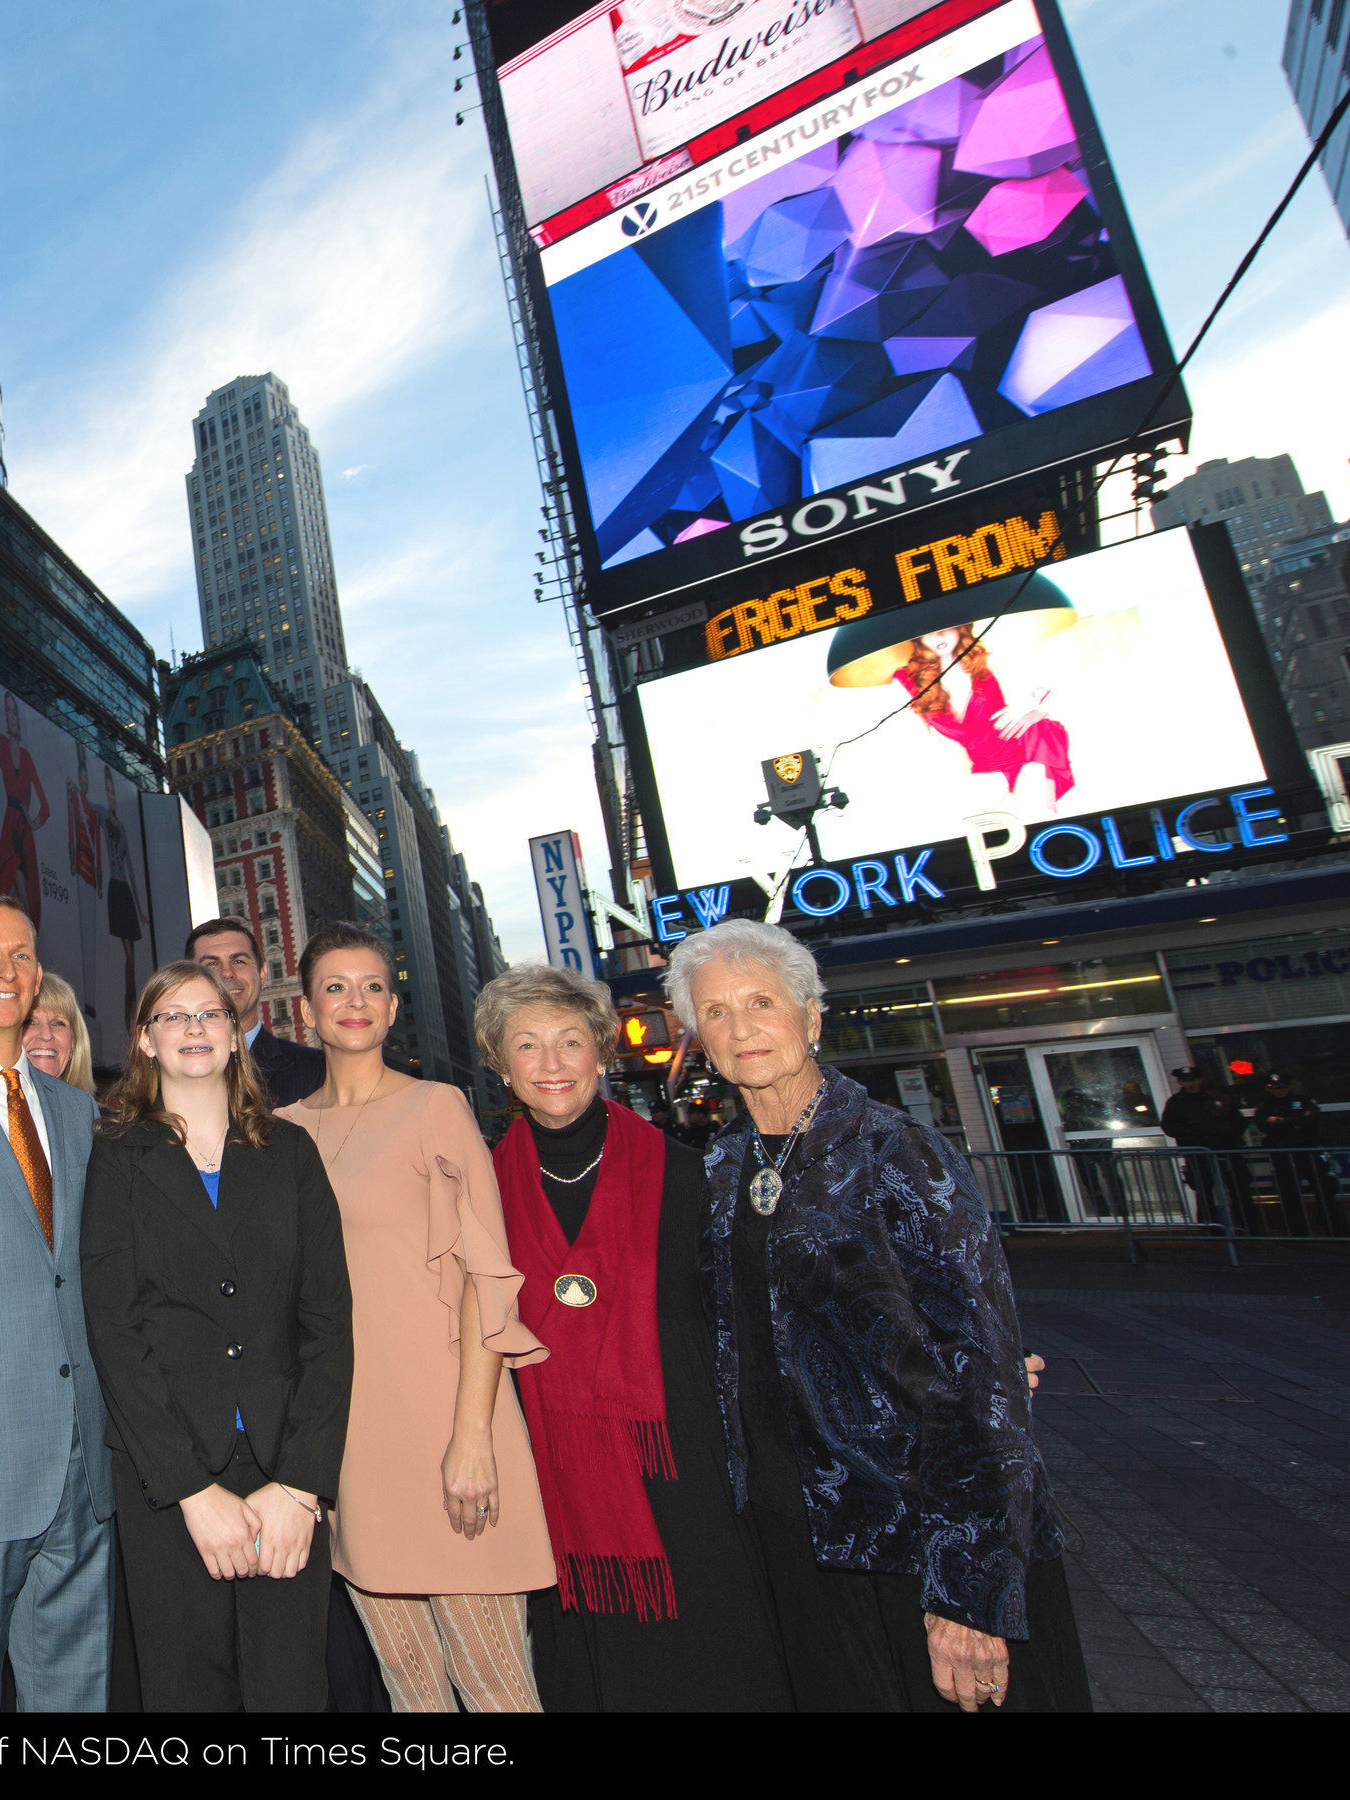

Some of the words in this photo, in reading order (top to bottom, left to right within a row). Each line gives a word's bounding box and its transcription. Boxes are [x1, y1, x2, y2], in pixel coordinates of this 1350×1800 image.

[632, 0, 837, 116] Budweise
[673, 87, 715, 112] KING
[723, 69, 747, 86] OF
[756, 32, 811, 68] BEERS
[667, 168, 723, 211] 21ST
[727, 96, 858, 178] CENTURY
[863, 64, 925, 110] FOX
[739, 449, 971, 557] SONY
[705, 567, 873, 661] ERGES
[895, 510, 1067, 602] FROM
[540, 839, 583, 975] NYPD
[588, 879, 731, 950] NEW
[739, 848, 945, 925] YORK
[962, 786, 1289, 892] POLICE
[1215, 949, 1350, 986] POLIC
